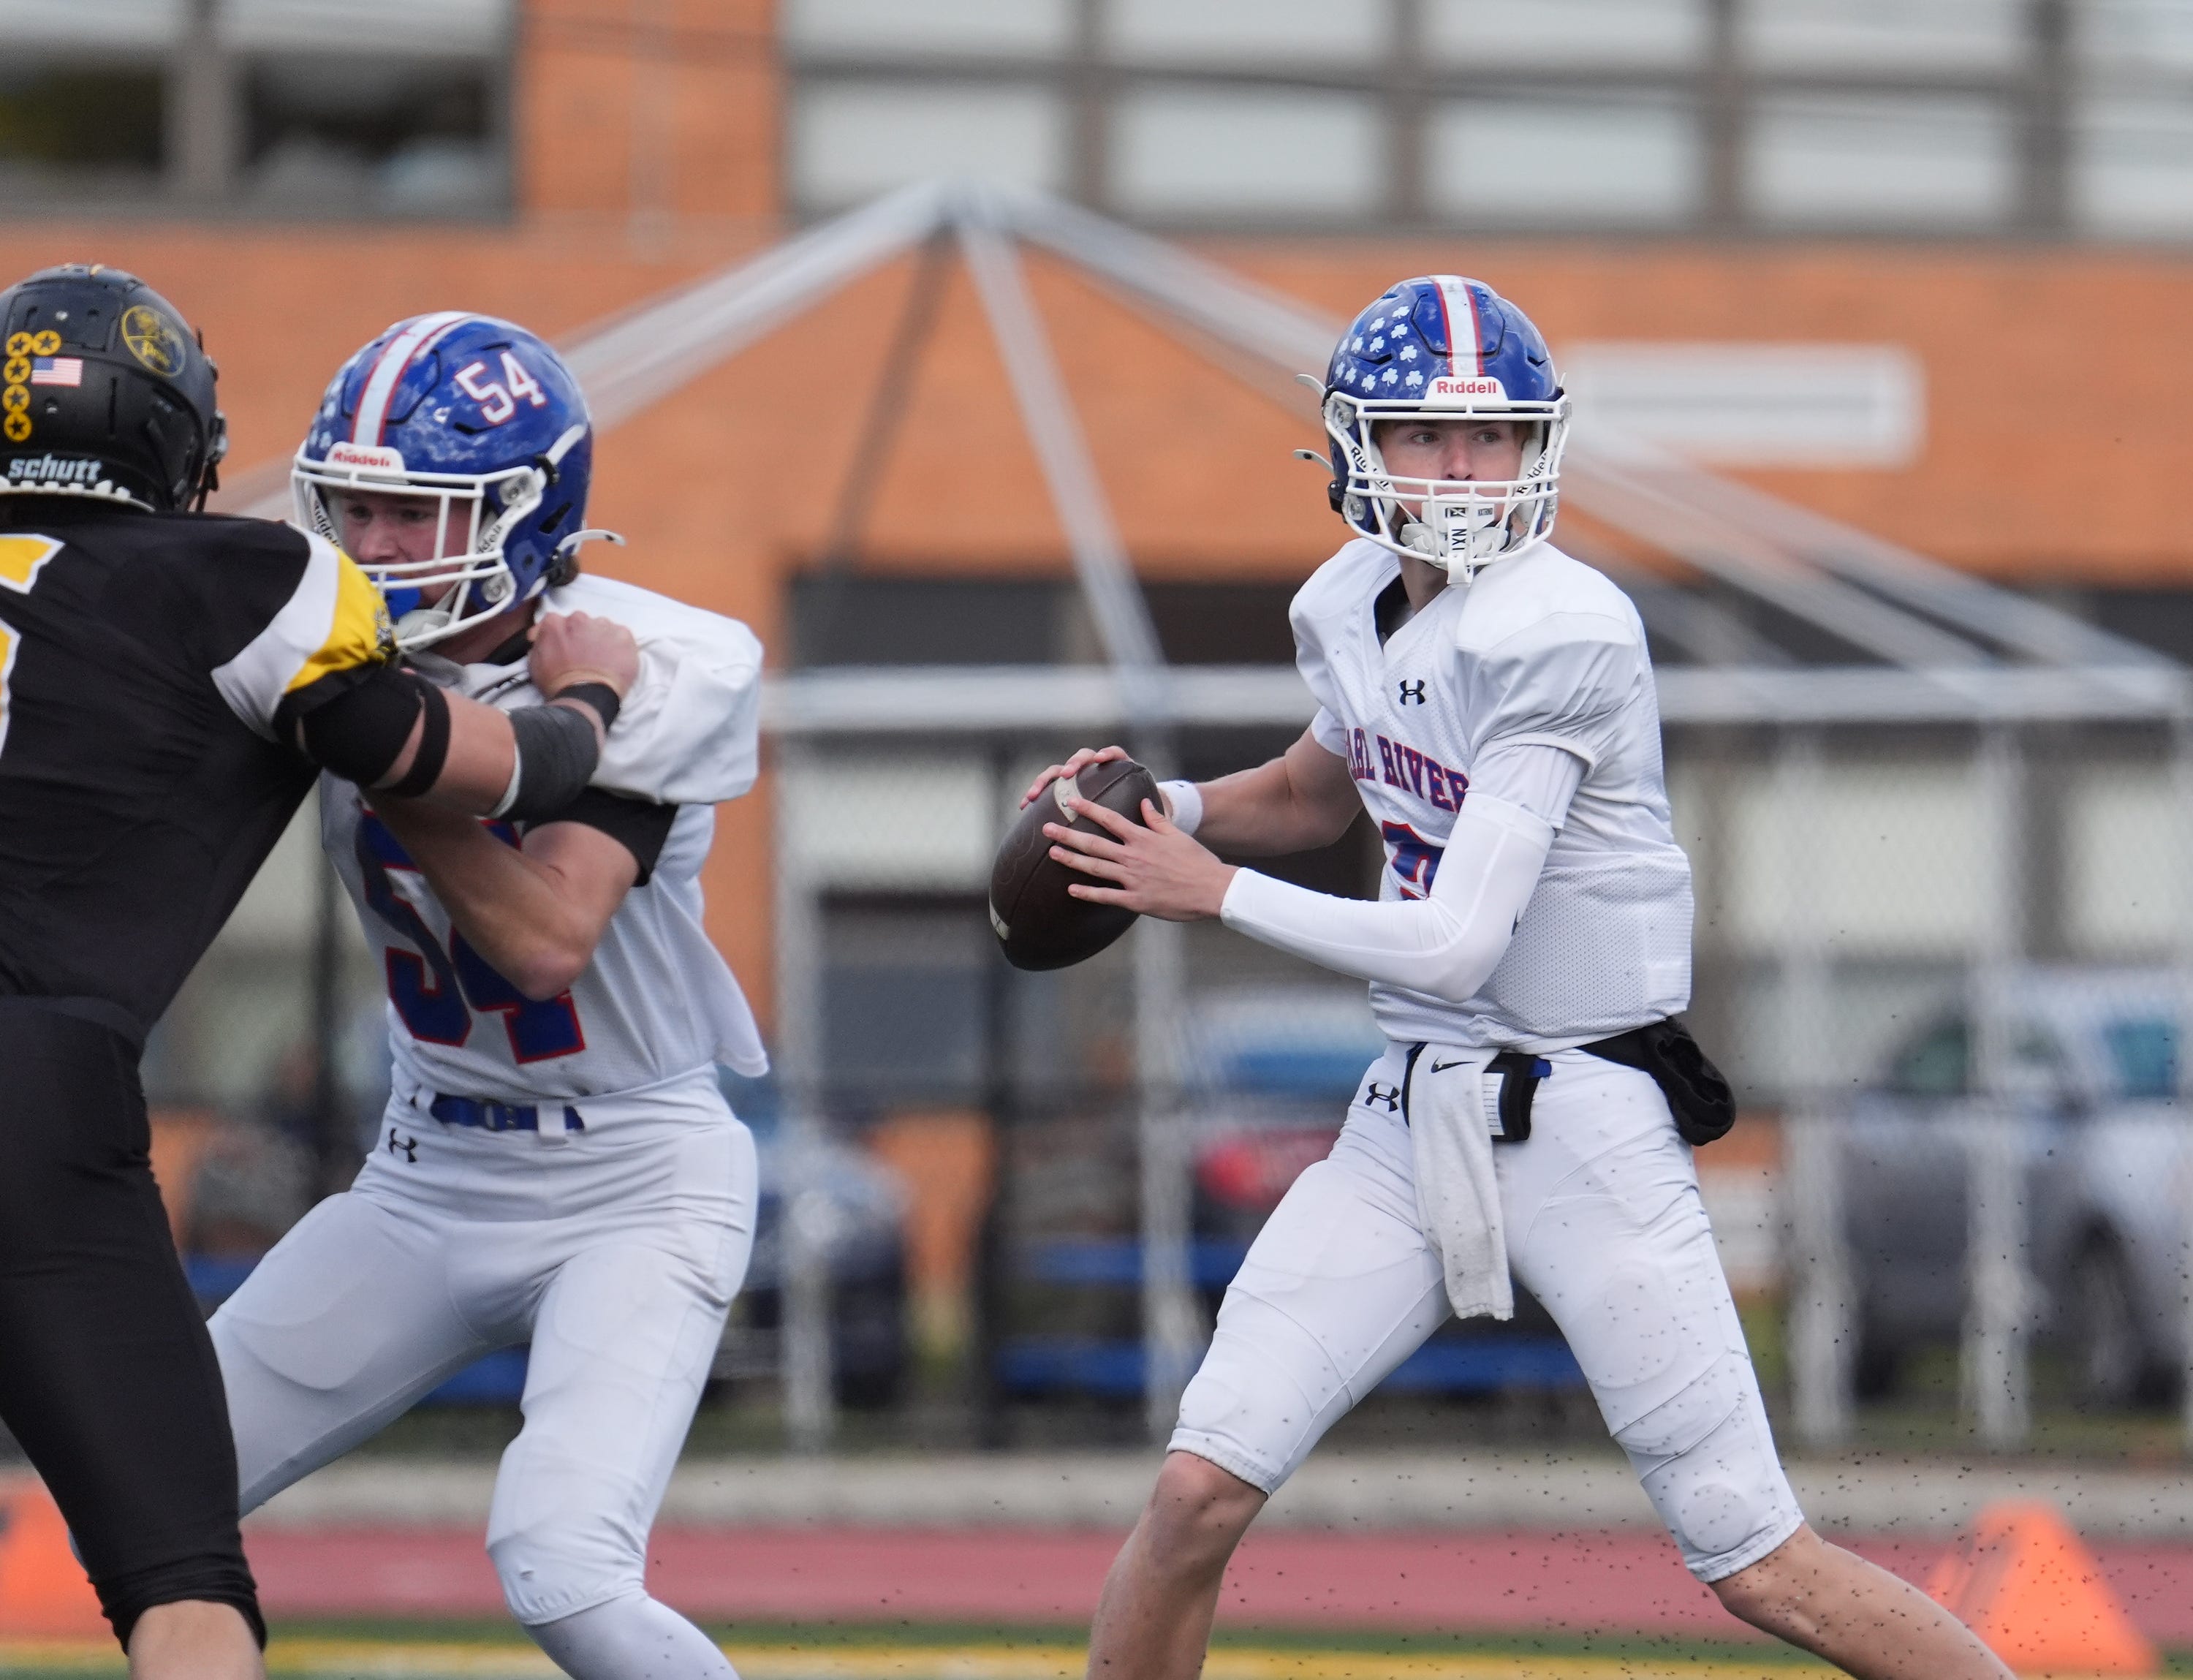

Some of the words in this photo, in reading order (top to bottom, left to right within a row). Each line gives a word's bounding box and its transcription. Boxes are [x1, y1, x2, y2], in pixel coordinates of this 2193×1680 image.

[454, 352, 548, 427] 54
[1437, 380, 1497, 394] Riddell
[7, 452, 102, 483] schutt
